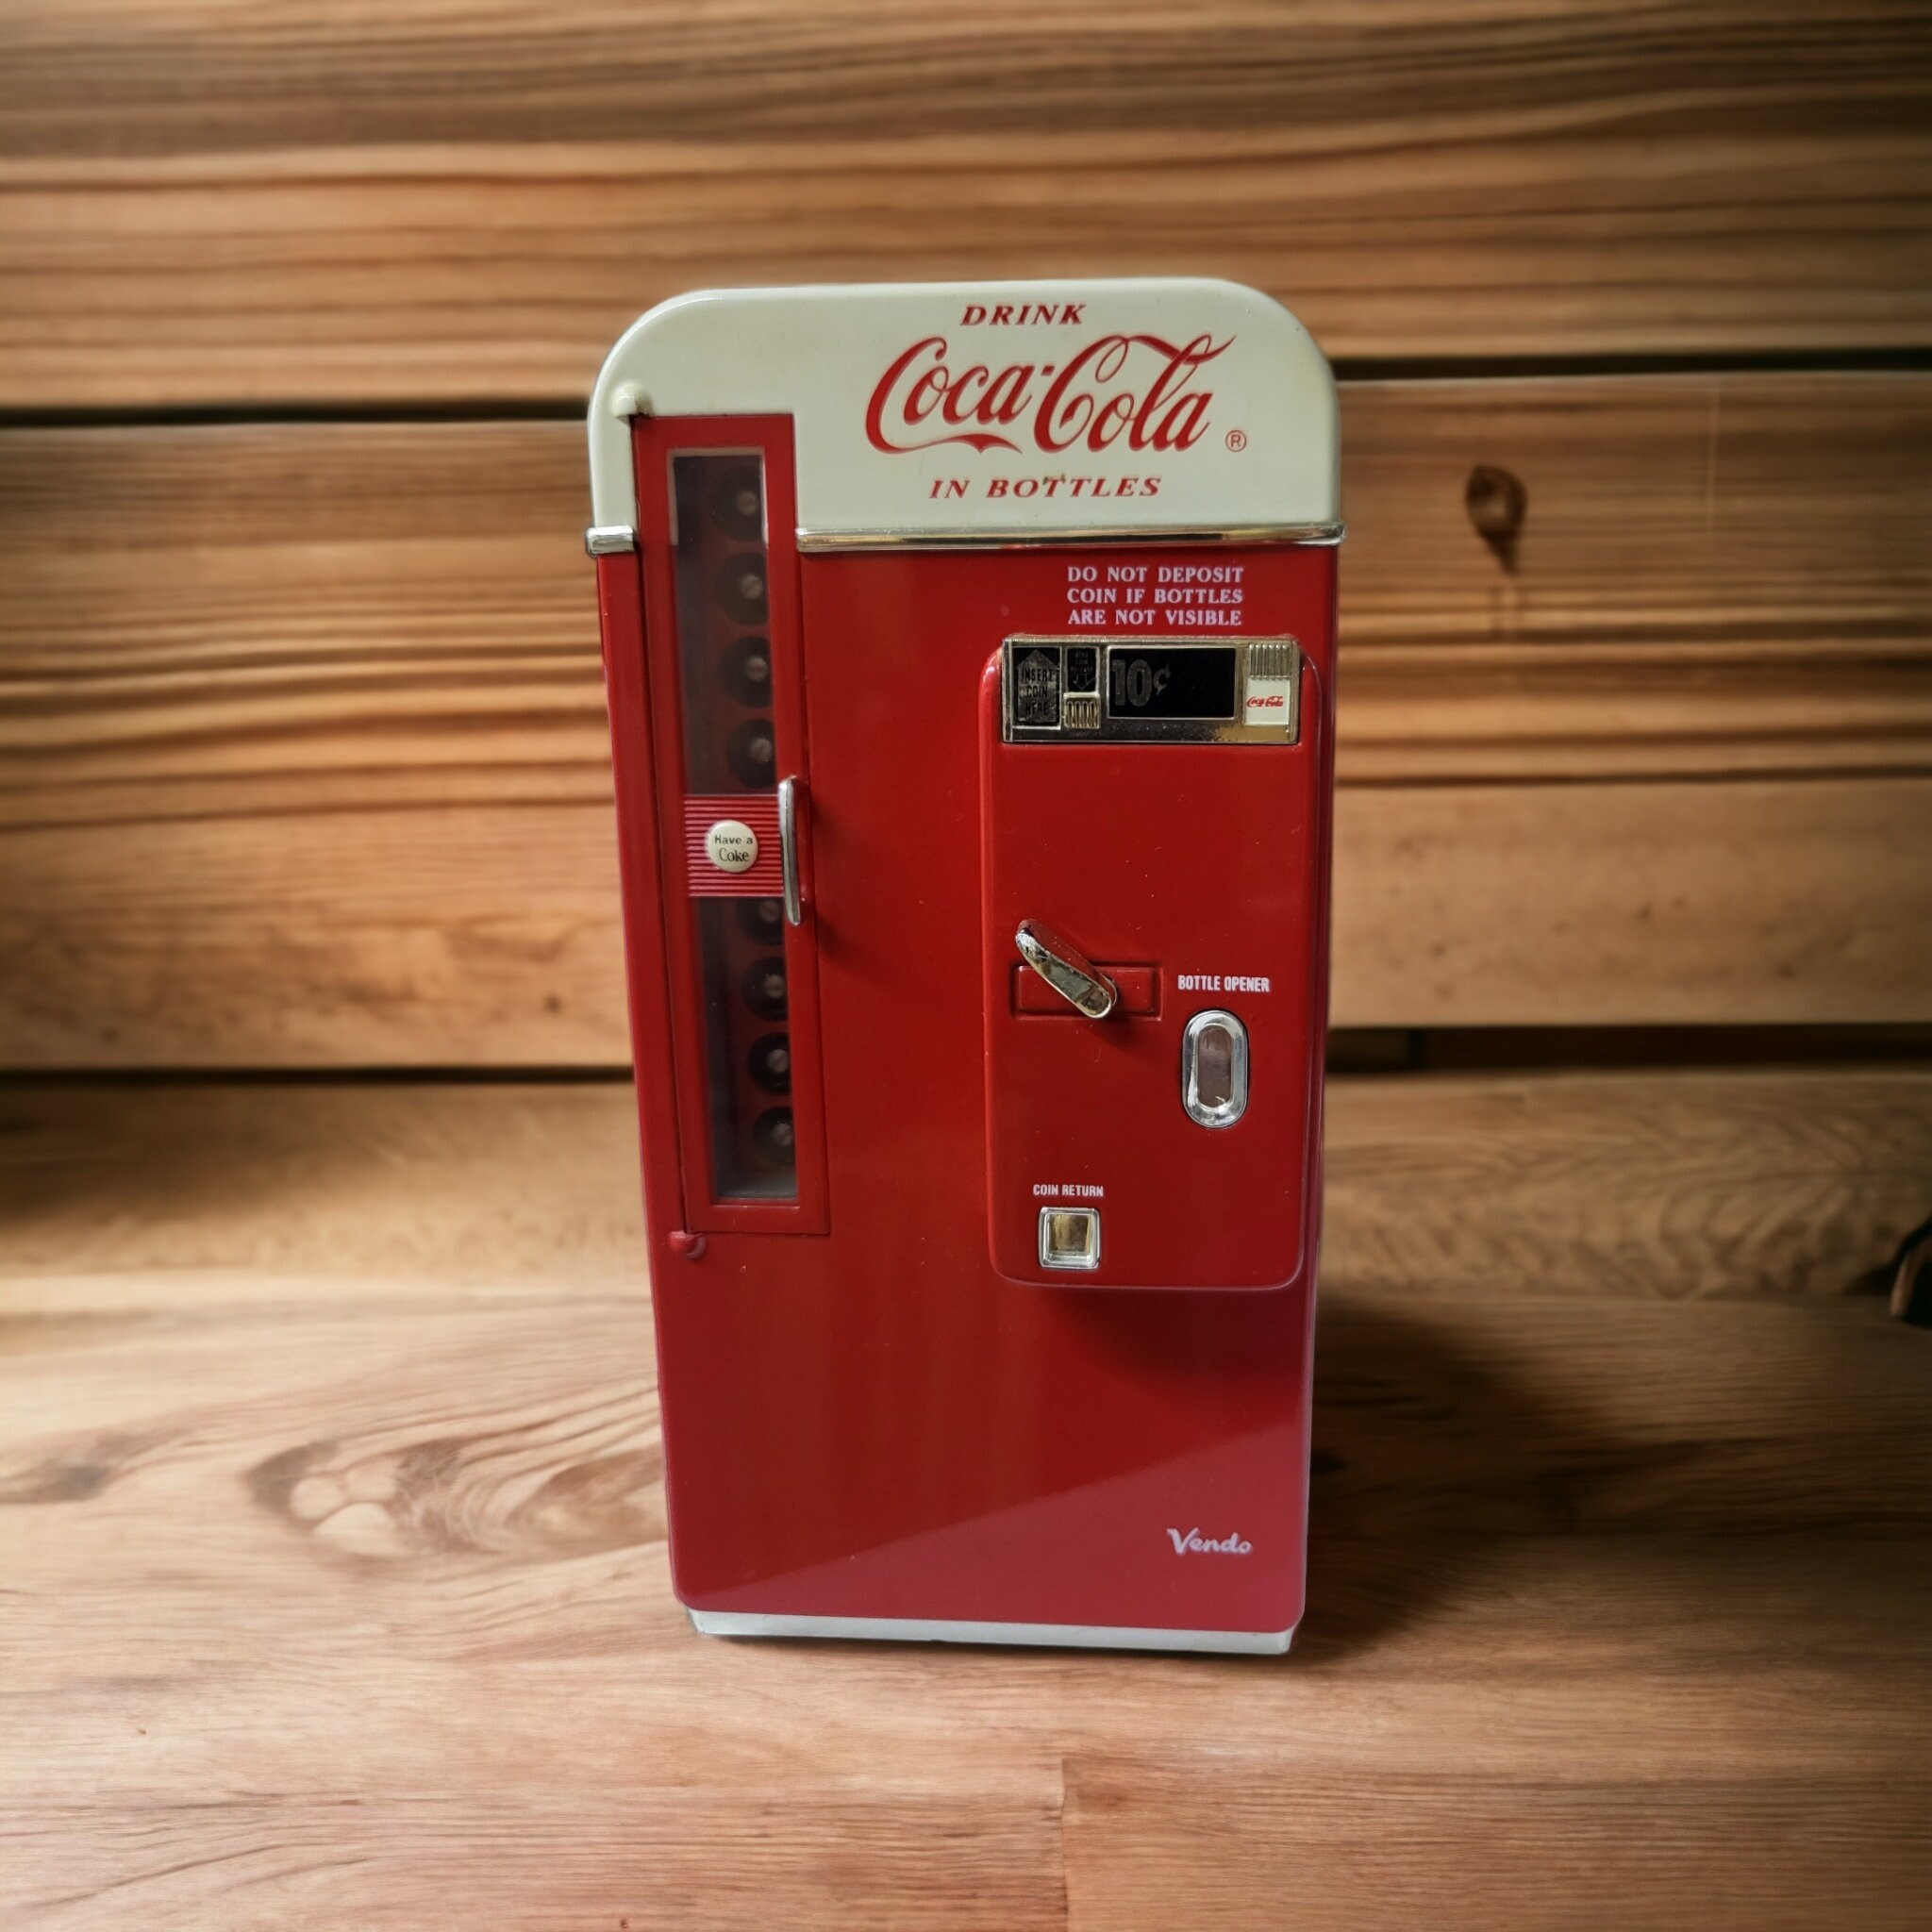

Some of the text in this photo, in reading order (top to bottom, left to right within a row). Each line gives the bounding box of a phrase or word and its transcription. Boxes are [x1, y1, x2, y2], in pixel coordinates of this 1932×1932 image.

[959, 304, 1087, 326] DRINK
[864, 334, 1237, 455] Coca-Cola
[928, 476, 1162, 499] IN BOTTLES
[1067, 566, 1244, 583] DO NOT DEPOSIT
[1066, 588, 1243, 605] COIN IF BOTTLES
[1067, 609, 1242, 626] ARE NOT VISIBLE
[1021, 668, 1053, 682] INSERT
[1026, 685, 1048, 698] COIN
[714, 835, 754, 845] Have a
[719, 848, 750, 862] Coke
[1177, 974, 1271, 993] BOTTLE OPENER
[1033, 1184, 1104, 1197] COIN RETURN
[1166, 1526, 1254, 1556] Vendo
